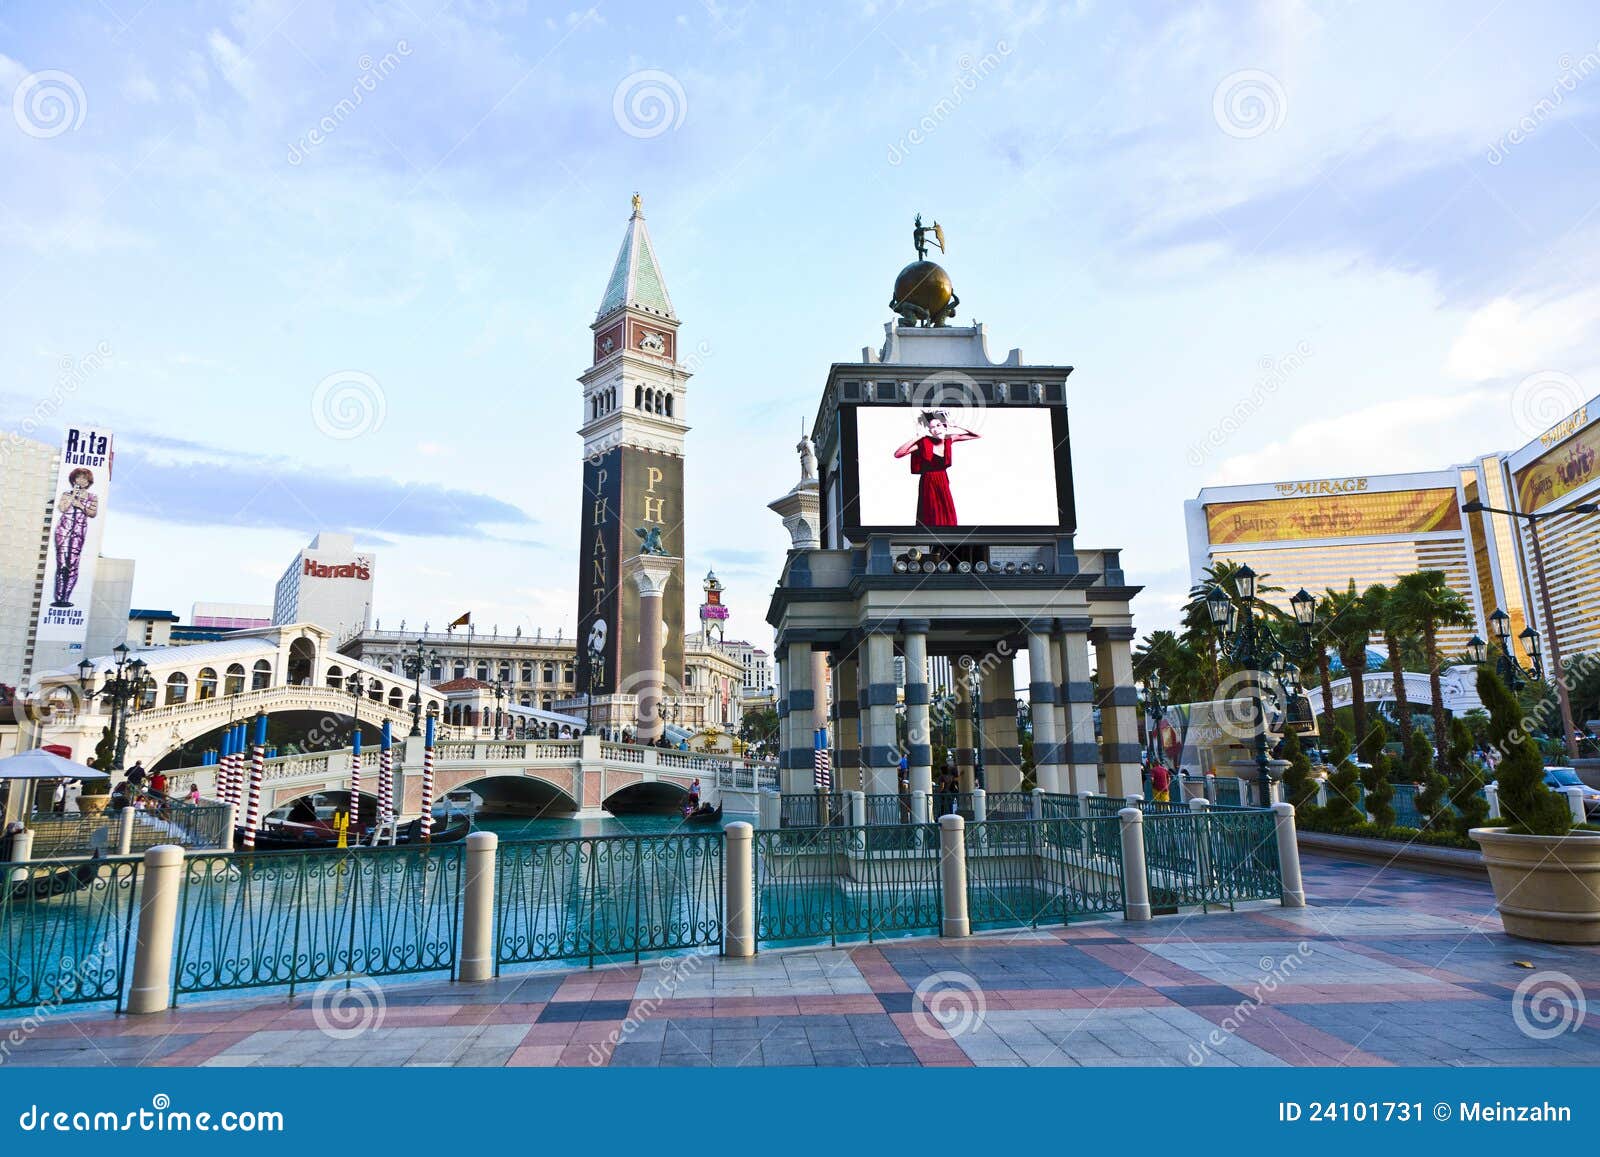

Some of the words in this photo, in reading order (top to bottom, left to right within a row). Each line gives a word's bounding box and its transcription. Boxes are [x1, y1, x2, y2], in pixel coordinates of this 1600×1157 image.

[66, 429, 107, 455] Rita
[65, 452, 105, 467] Rudner
[1294, 479, 1368, 495] MIRAGE
